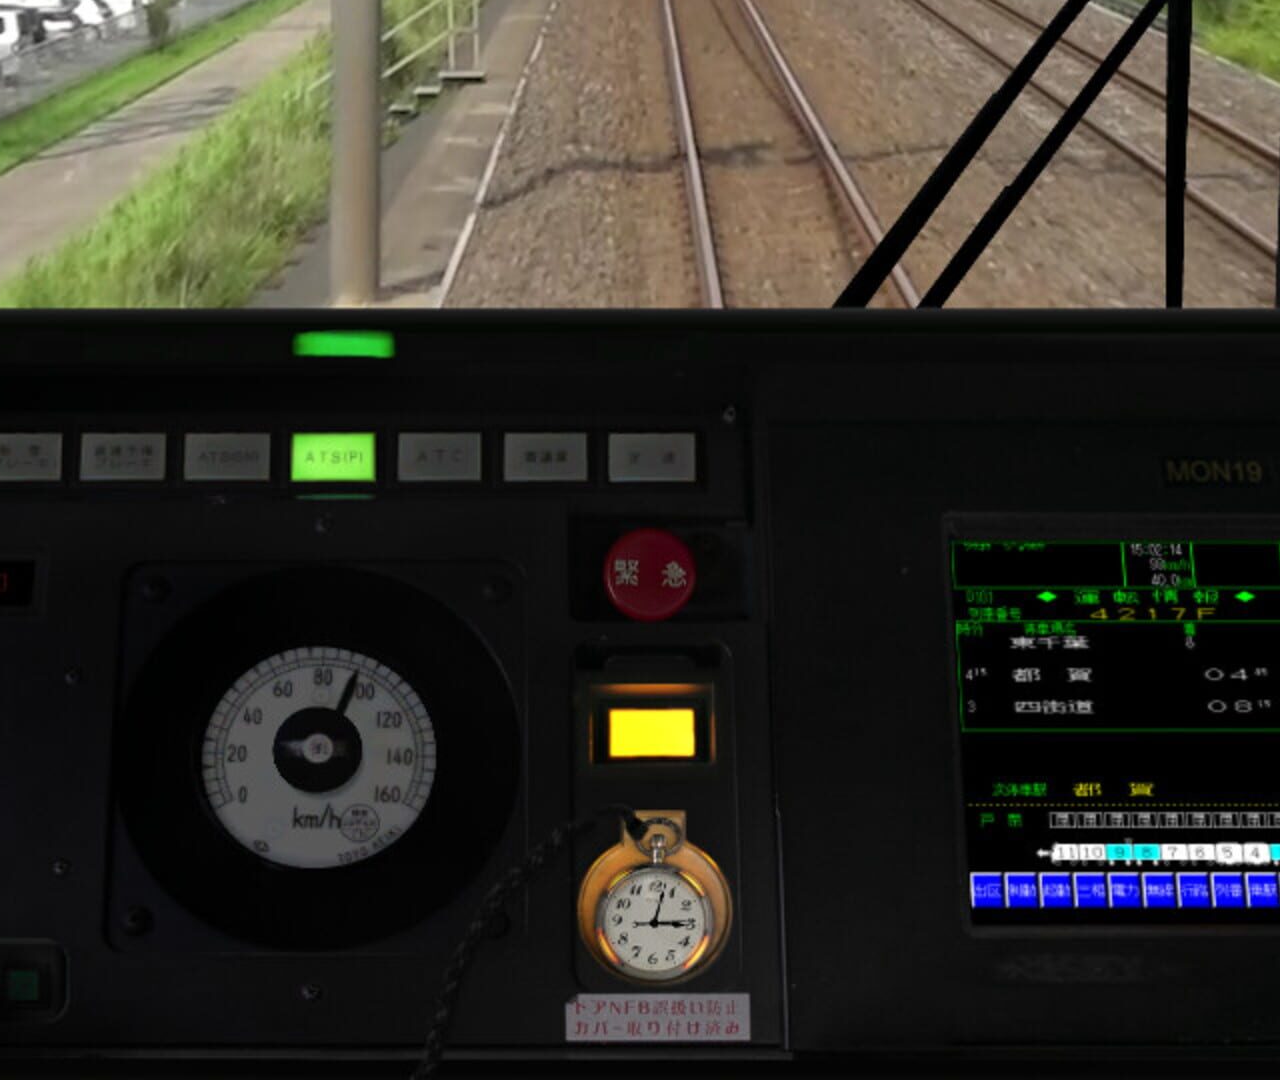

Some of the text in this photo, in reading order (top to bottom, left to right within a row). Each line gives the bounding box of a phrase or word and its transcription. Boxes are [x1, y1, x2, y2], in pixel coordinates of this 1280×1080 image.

[1165, 460, 1262, 483] MON19
[614, 559, 687, 588] 緊急
[1088, 607, 1217, 621] 4217F
[313, 669, 333, 687] 80
[272, 680, 293, 697] 60
[352, 683, 376, 700] 00
[243, 707, 263, 725] 40
[375, 711, 403, 729] 120
[227, 744, 247, 762] 20
[386, 748, 414, 766] 140
[373, 786, 401, 803] 160
[291, 803, 342, 830] km/h
